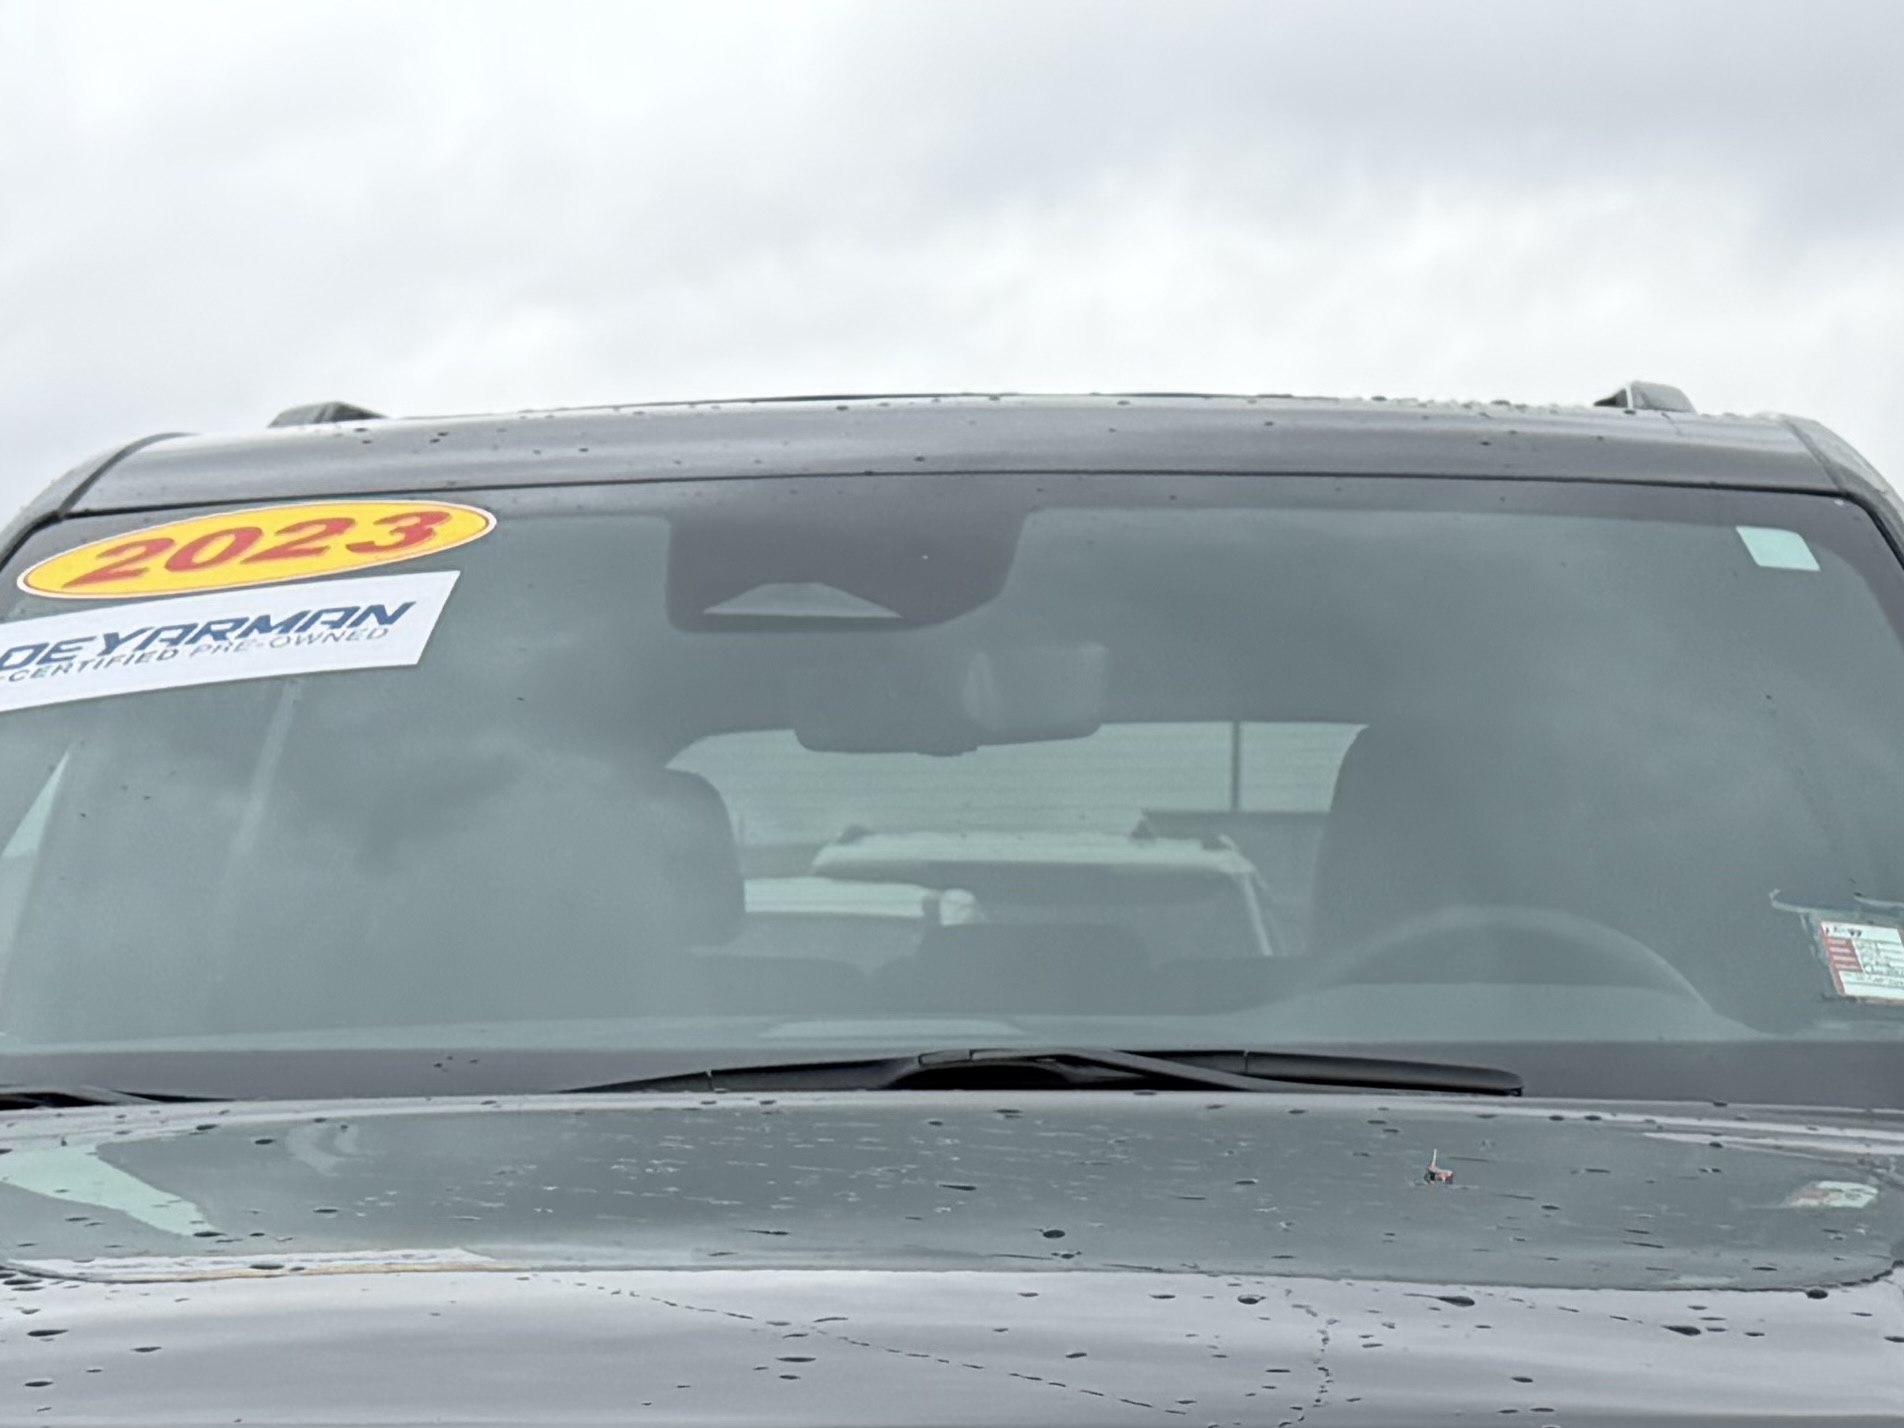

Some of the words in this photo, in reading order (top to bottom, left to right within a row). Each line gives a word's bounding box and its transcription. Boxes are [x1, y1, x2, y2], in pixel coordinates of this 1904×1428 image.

[63, 511, 453, 589] 2023
[7, 647, 181, 683] CERTIFIED
[190, 626, 391, 657] PRE-OWNED
